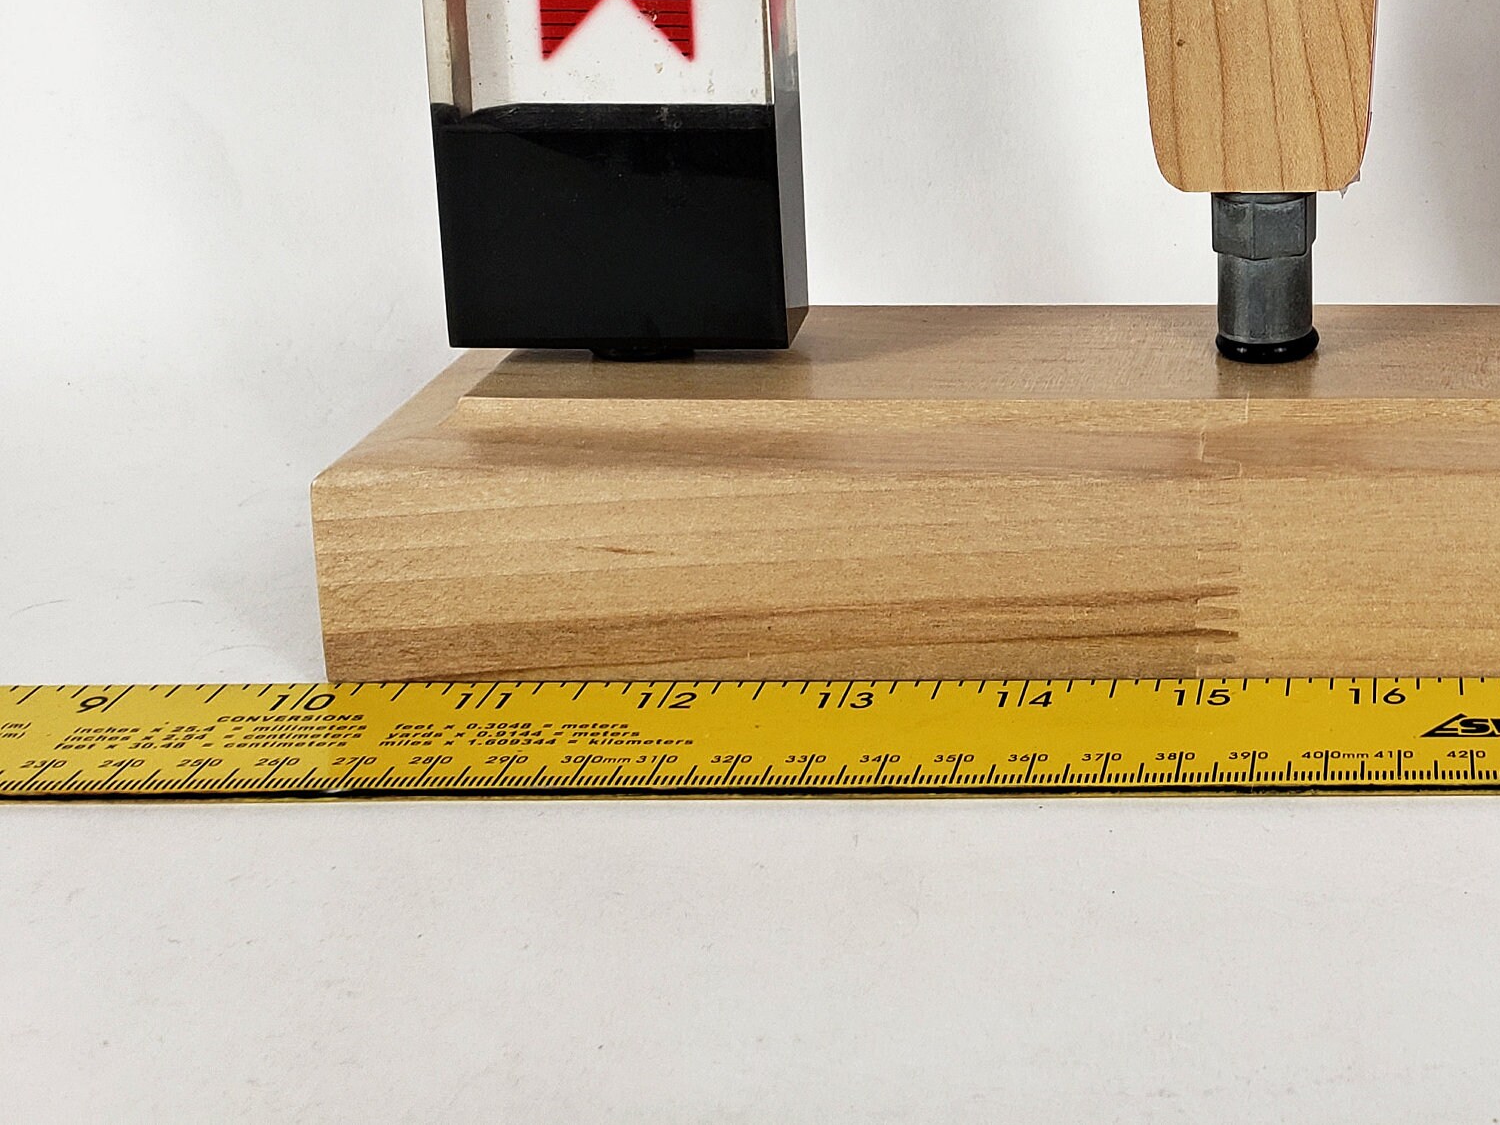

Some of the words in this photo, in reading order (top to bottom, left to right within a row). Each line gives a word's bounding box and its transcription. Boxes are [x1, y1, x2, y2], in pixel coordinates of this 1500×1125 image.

[77, 696, 108, 713] 9
[269, 694, 336, 711] 10
[455, 692, 513, 709] 11
[637, 692, 698, 709] 12
[817, 692, 874, 709] 13
[997, 691, 1052, 707] 14
[1174, 689, 1231, 706] 15
[1349, 687, 1406, 705] 16
[216, 714, 364, 723] CONVERSIONS
[73, 726, 141, 734] inches
[171, 725, 216, 733] 25.4
[466, 722, 532, 730] 0.3048
[64, 734, 131, 742] inches
[162, 733, 208, 741] 2.54
[243, 732, 363, 740] centimeters
[385, 731, 443, 739] yards
[476, 730, 543, 738] 0.9144
[53, 742, 96, 750] feet
[128, 741, 186, 749] 30.48
[379, 739, 433, 747] miles
[468, 738, 556, 746] 1.609344
[20, 760, 67, 769] 230
[98, 759, 146, 768] 240
[177, 758, 223, 768] 250
[254, 757, 300, 767] 260
[332, 756, 378, 766] 270
[408, 755, 454, 765] 280
[485, 755, 529, 765] 290
[636, 755, 679, 764] 310
[710, 754, 753, 764] 320
[785, 754, 827, 764] 330
[859, 754, 901, 764] 340
[933, 753, 975, 763] 350
[1007, 753, 1049, 763] 360
[1081, 752, 1123, 762] 370
[1155, 751, 1196, 761] 380
[1228, 750, 1269, 760] 390
[1373, 750, 1414, 760] 410
[1446, 750, 1487, 759] 420
